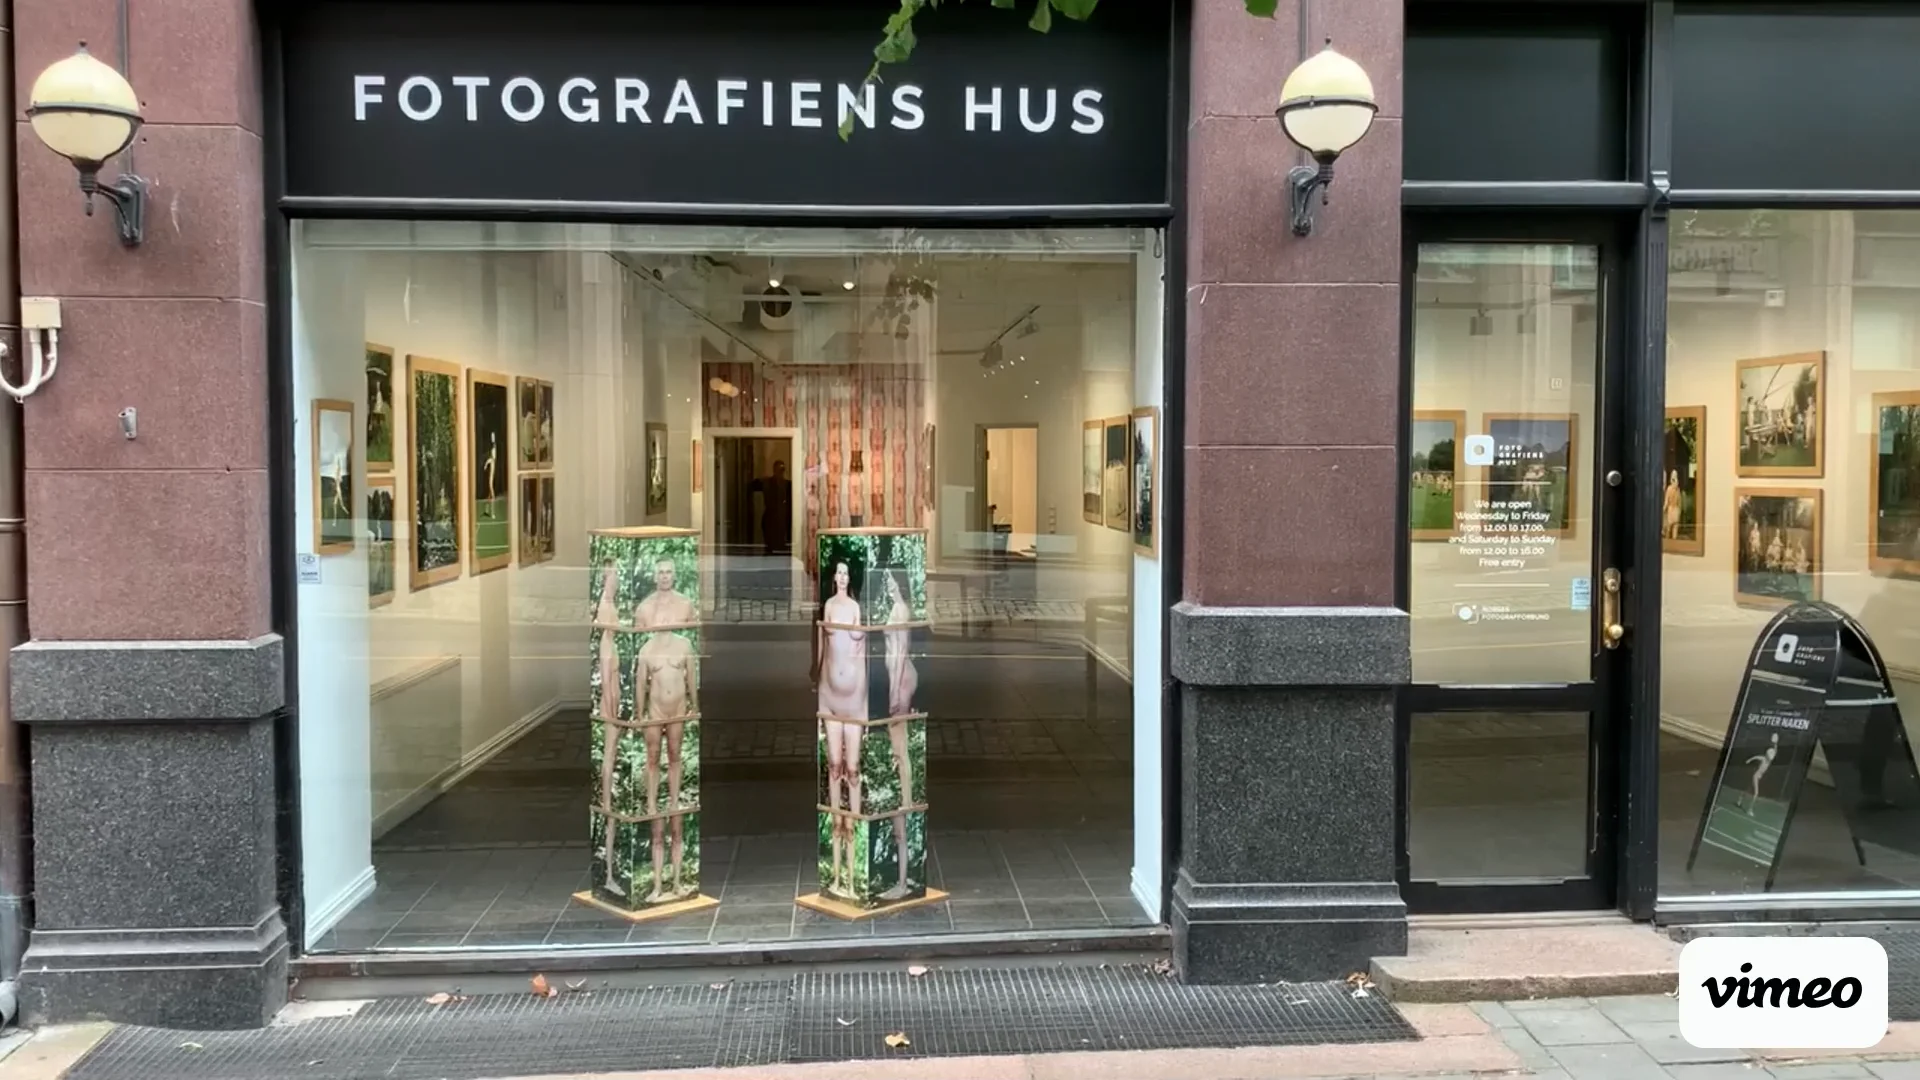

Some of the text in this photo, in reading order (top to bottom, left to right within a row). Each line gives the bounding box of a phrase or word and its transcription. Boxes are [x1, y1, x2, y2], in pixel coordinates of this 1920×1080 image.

[354, 75, 1105, 135] FOTOGRAFIENS HUS
[1474, 500, 1532, 511] We are open
[1455, 511, 1550, 523] Wednesday to Friday
[1459, 523, 1481, 533] from
[1484, 524, 1507, 533] 12.00
[1509, 523, 1518, 533] to
[1448, 535, 1556, 546] and Saturday to Sunday
[1460, 546, 1482, 556] from
[1484, 547, 1507, 556] 12.00
[1508, 546, 1518, 556] to
[1479, 558, 1526, 569] Free entry
[1781, 717, 1810, 730] NAKEN
